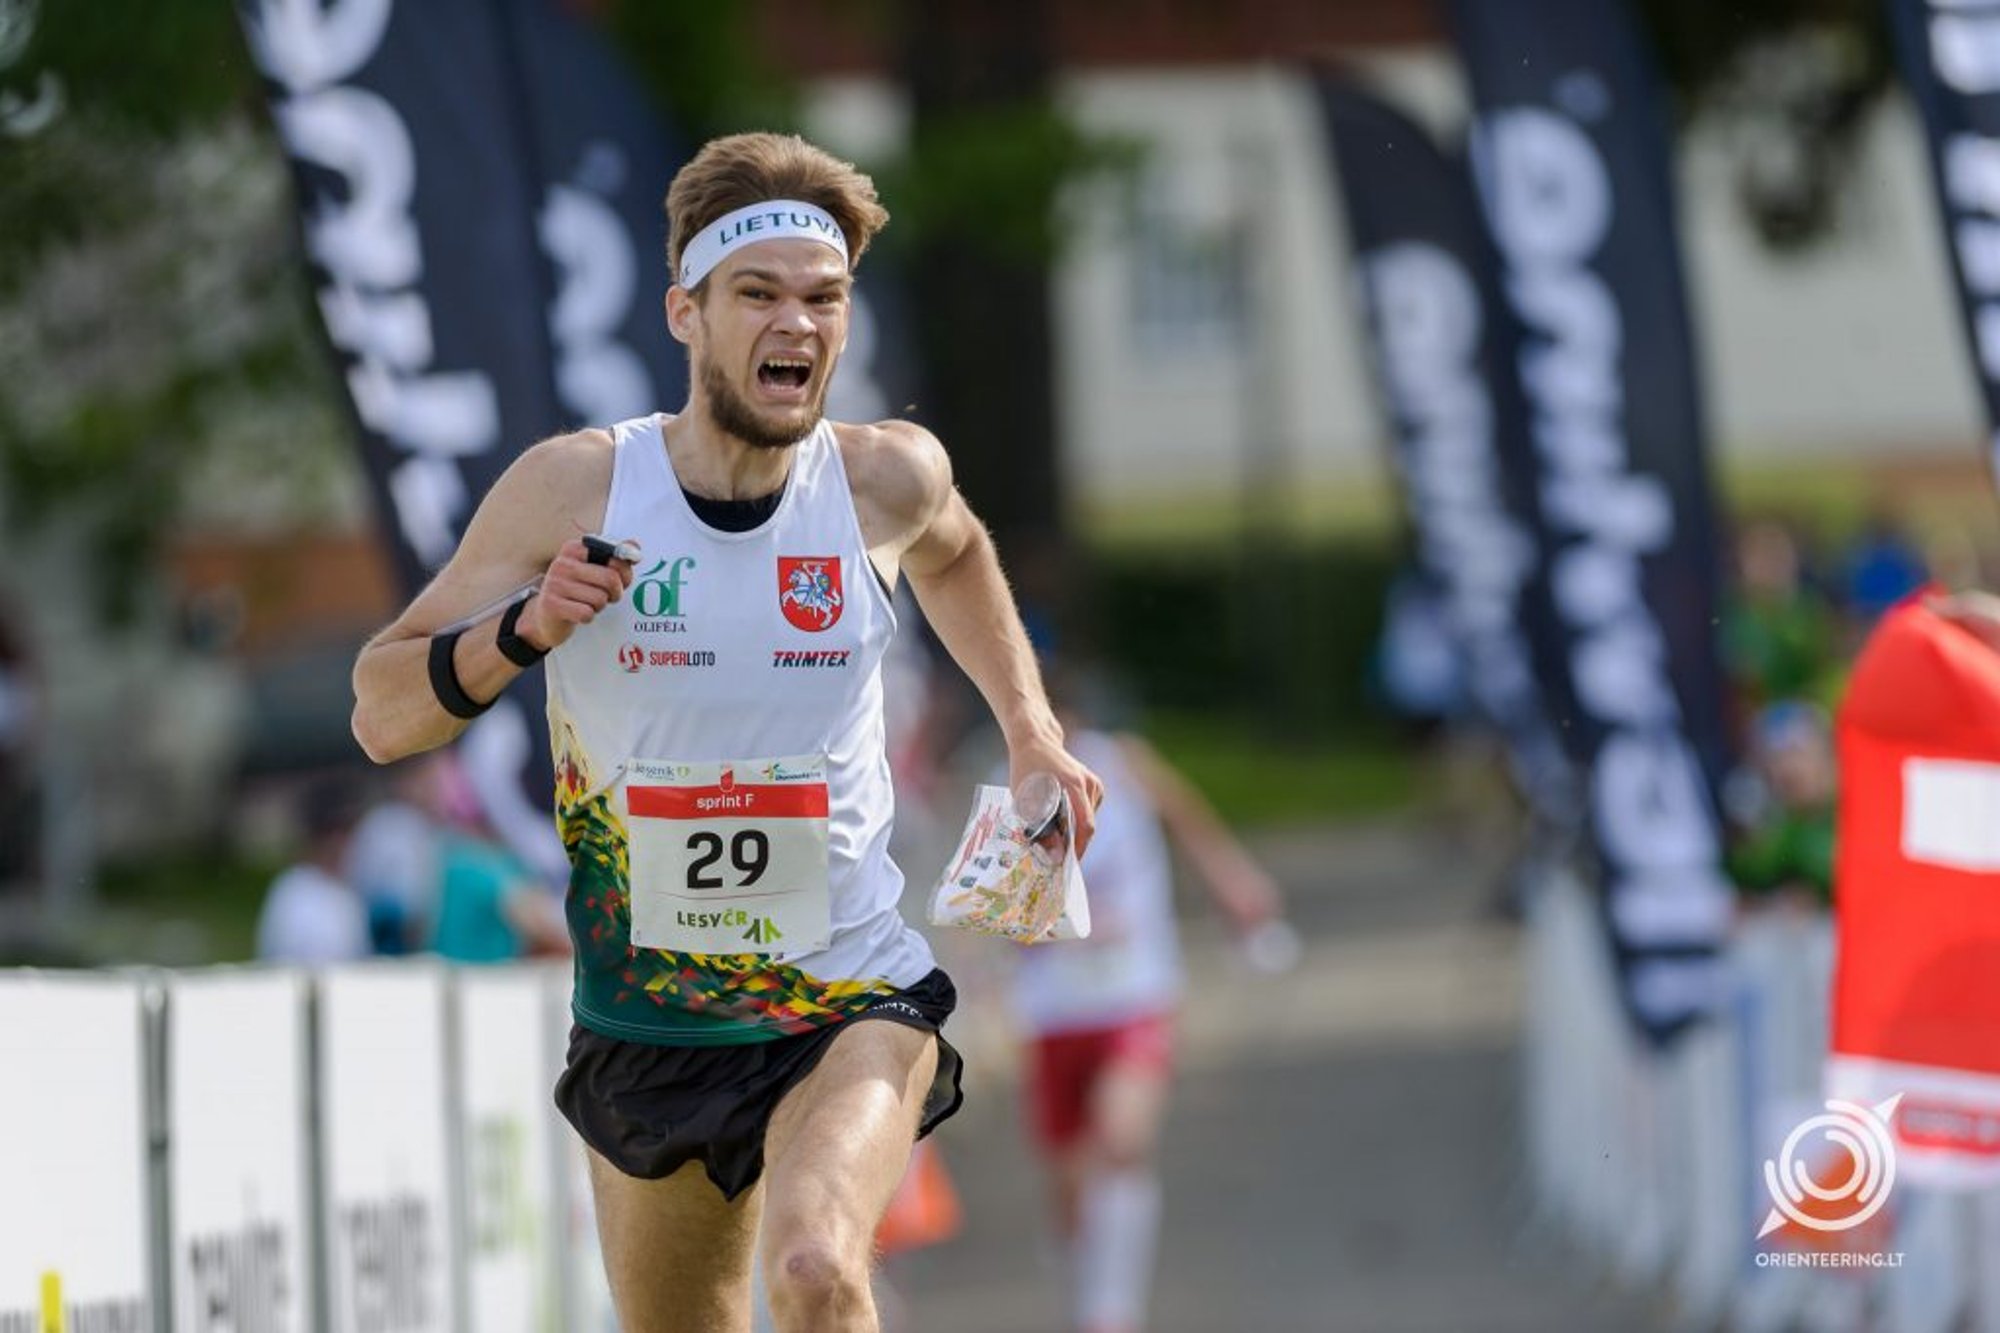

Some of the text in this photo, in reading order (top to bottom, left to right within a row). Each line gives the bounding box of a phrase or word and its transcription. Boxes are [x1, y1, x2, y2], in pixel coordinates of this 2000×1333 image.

[649, 651, 716, 667] SUPERLOTO
[773, 650, 850, 668] TRIMTEX
[697, 793, 754, 811] sprint F
[686, 829, 769, 889] 29
